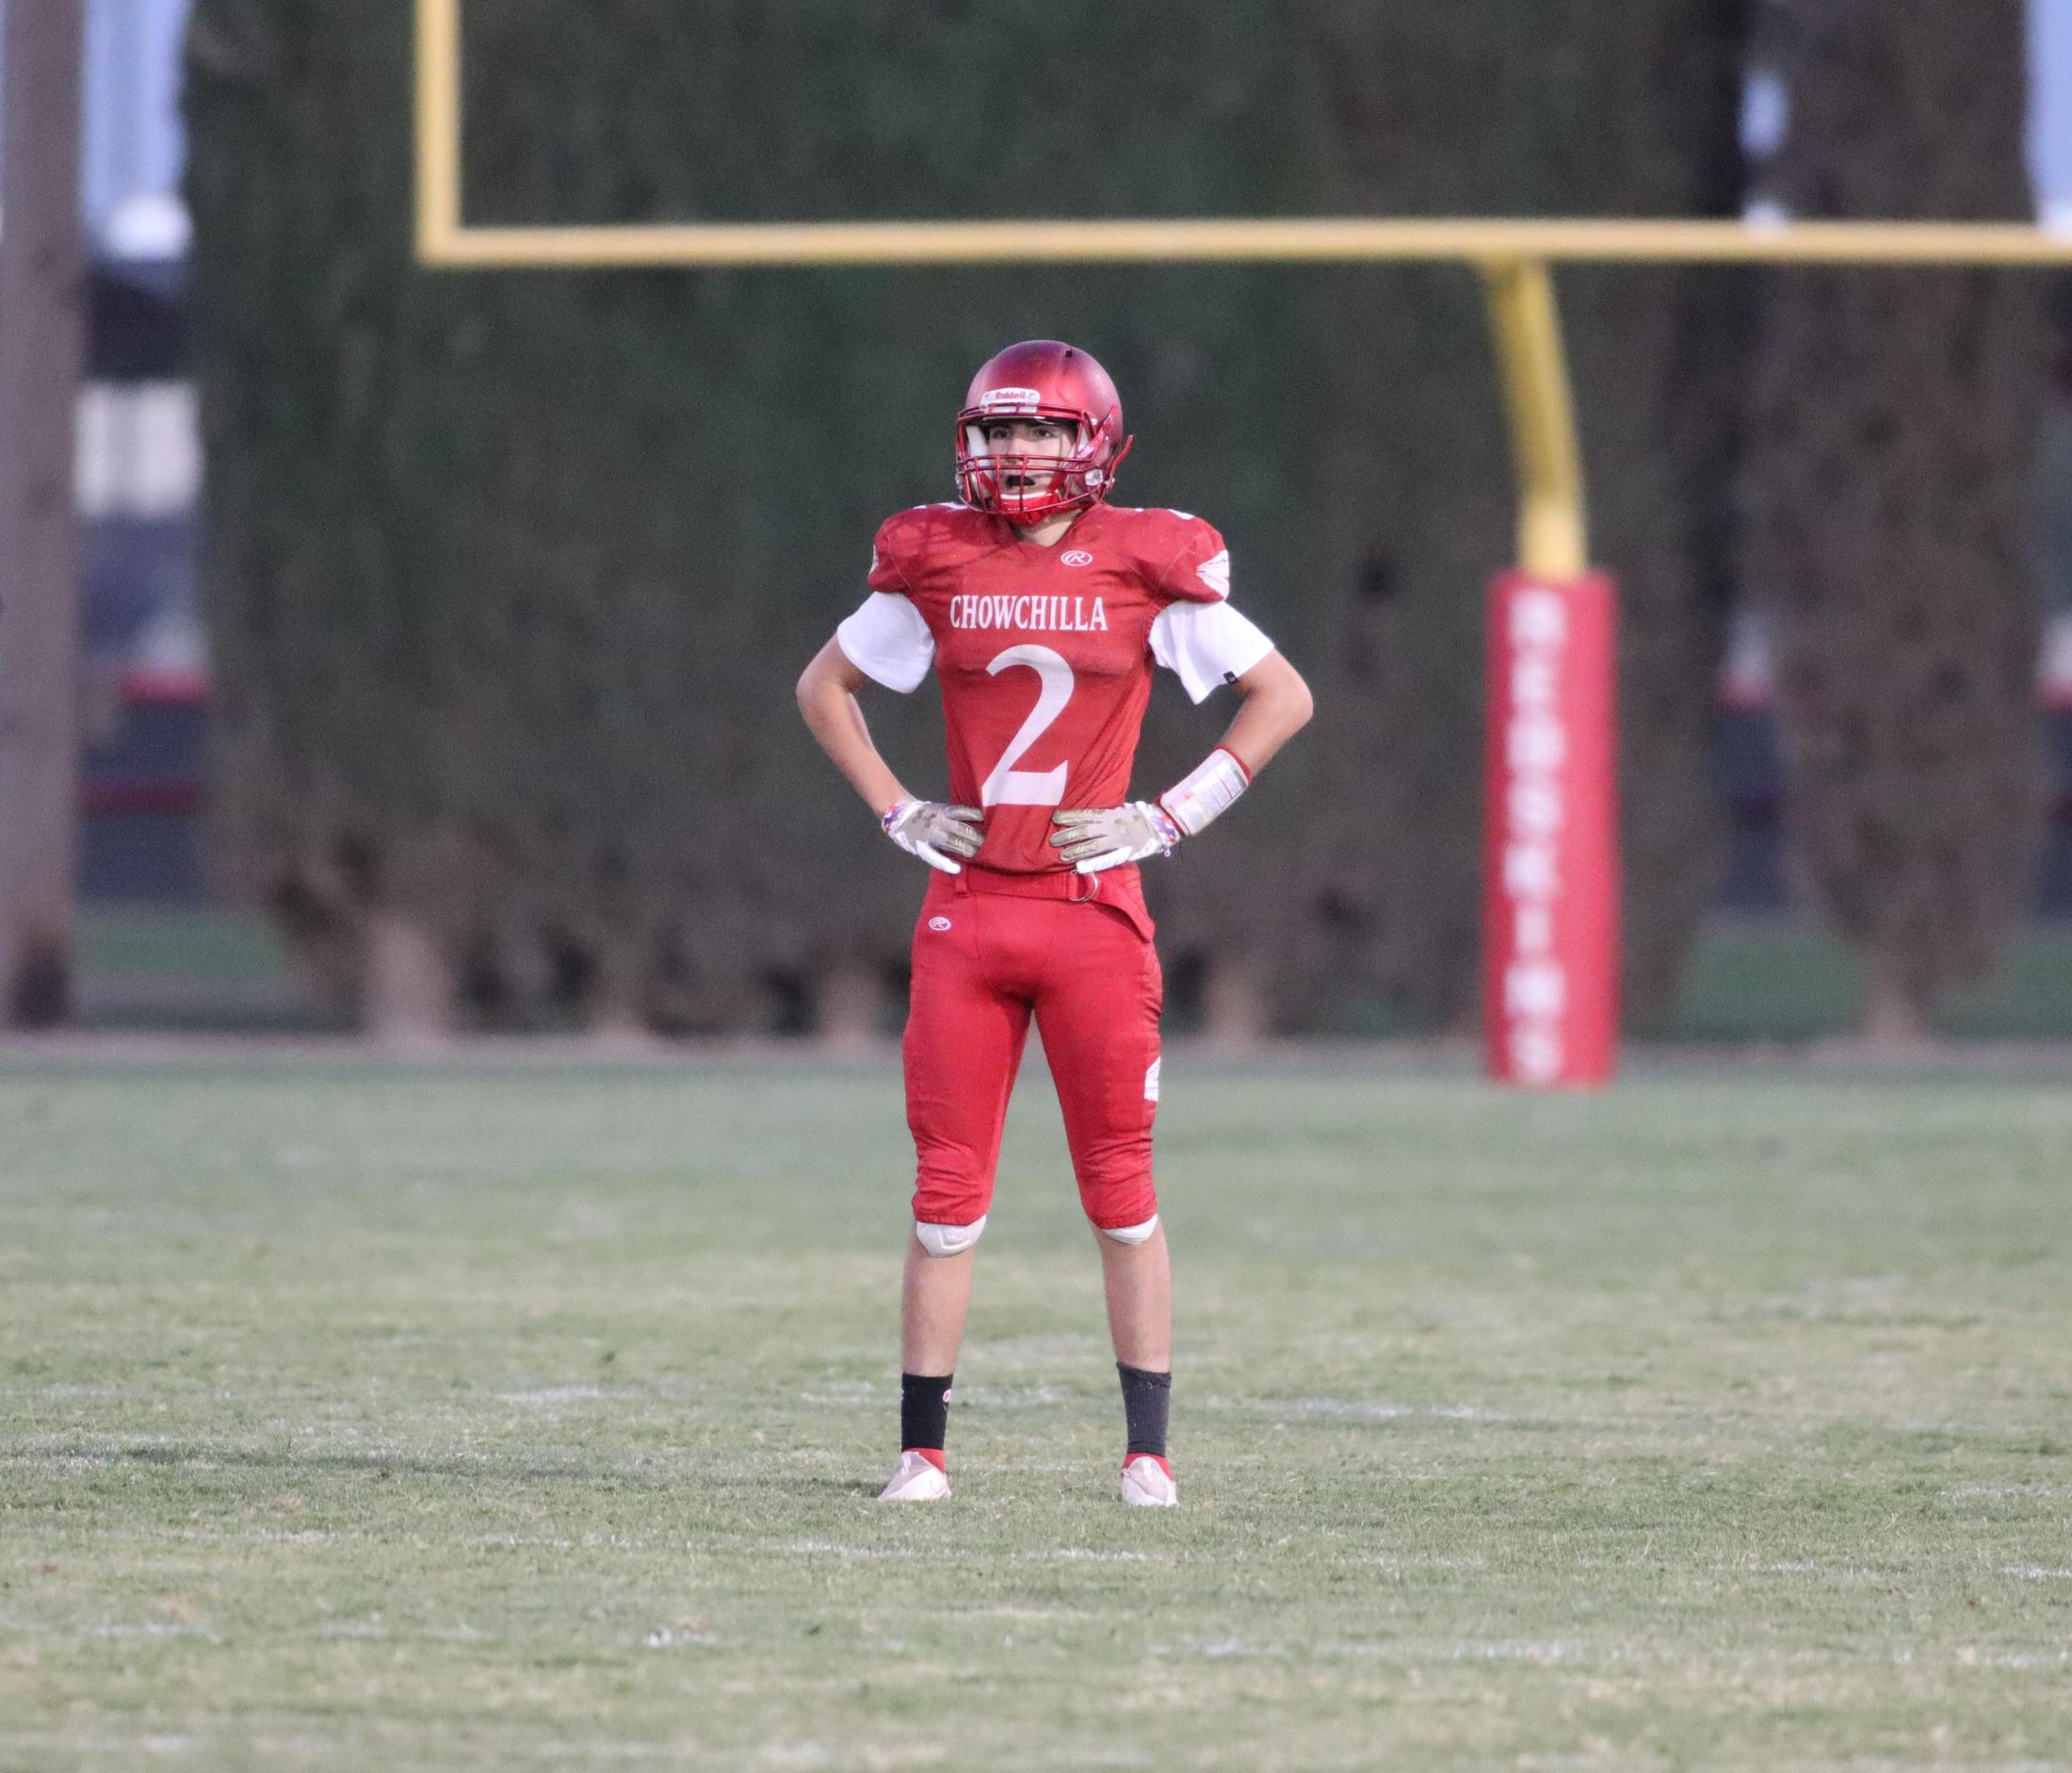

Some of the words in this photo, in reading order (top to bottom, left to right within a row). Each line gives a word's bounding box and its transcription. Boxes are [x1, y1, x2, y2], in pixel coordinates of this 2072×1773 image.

[995, 391, 1026, 399] Riddell
[950, 594, 1109, 631] CHOWCHILLA
[981, 643, 1075, 807] 2
